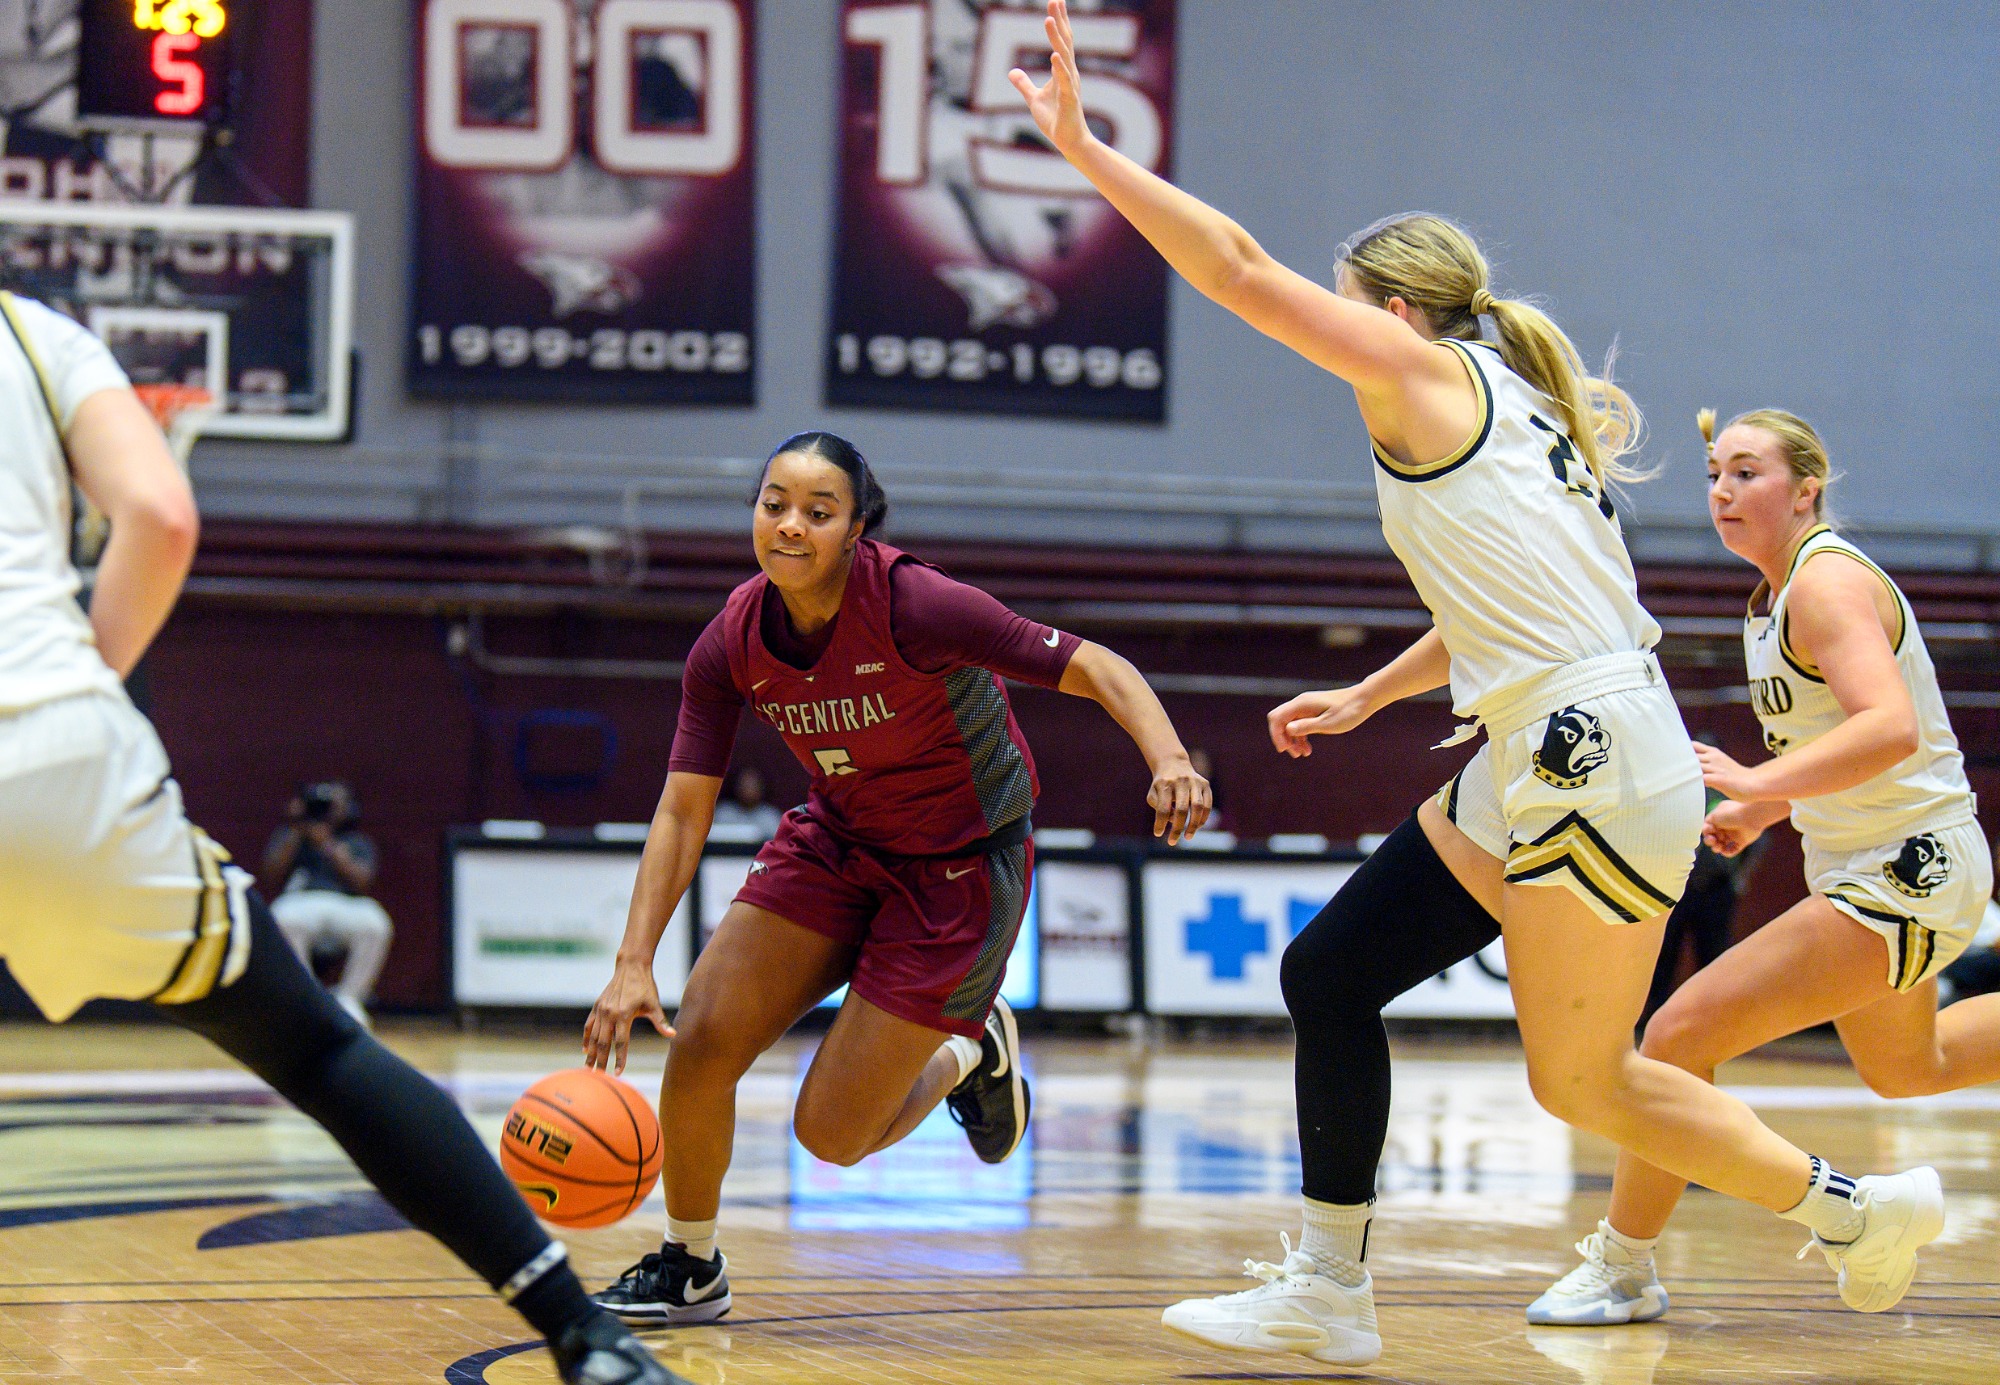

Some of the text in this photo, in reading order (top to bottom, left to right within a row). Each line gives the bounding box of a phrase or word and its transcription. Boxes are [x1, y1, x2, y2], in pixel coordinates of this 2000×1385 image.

[152, 30, 204, 115] 5
[424, 0, 742, 172] 00
[846, 5, 1163, 190] 15
[418, 324, 749, 373] 1999-2002
[838, 332, 1163, 390] 1992-1996
[855, 662, 885, 675] MEAC
[784, 692, 896, 734] CENTRAL
[506, 1110, 573, 1167] ELITE
